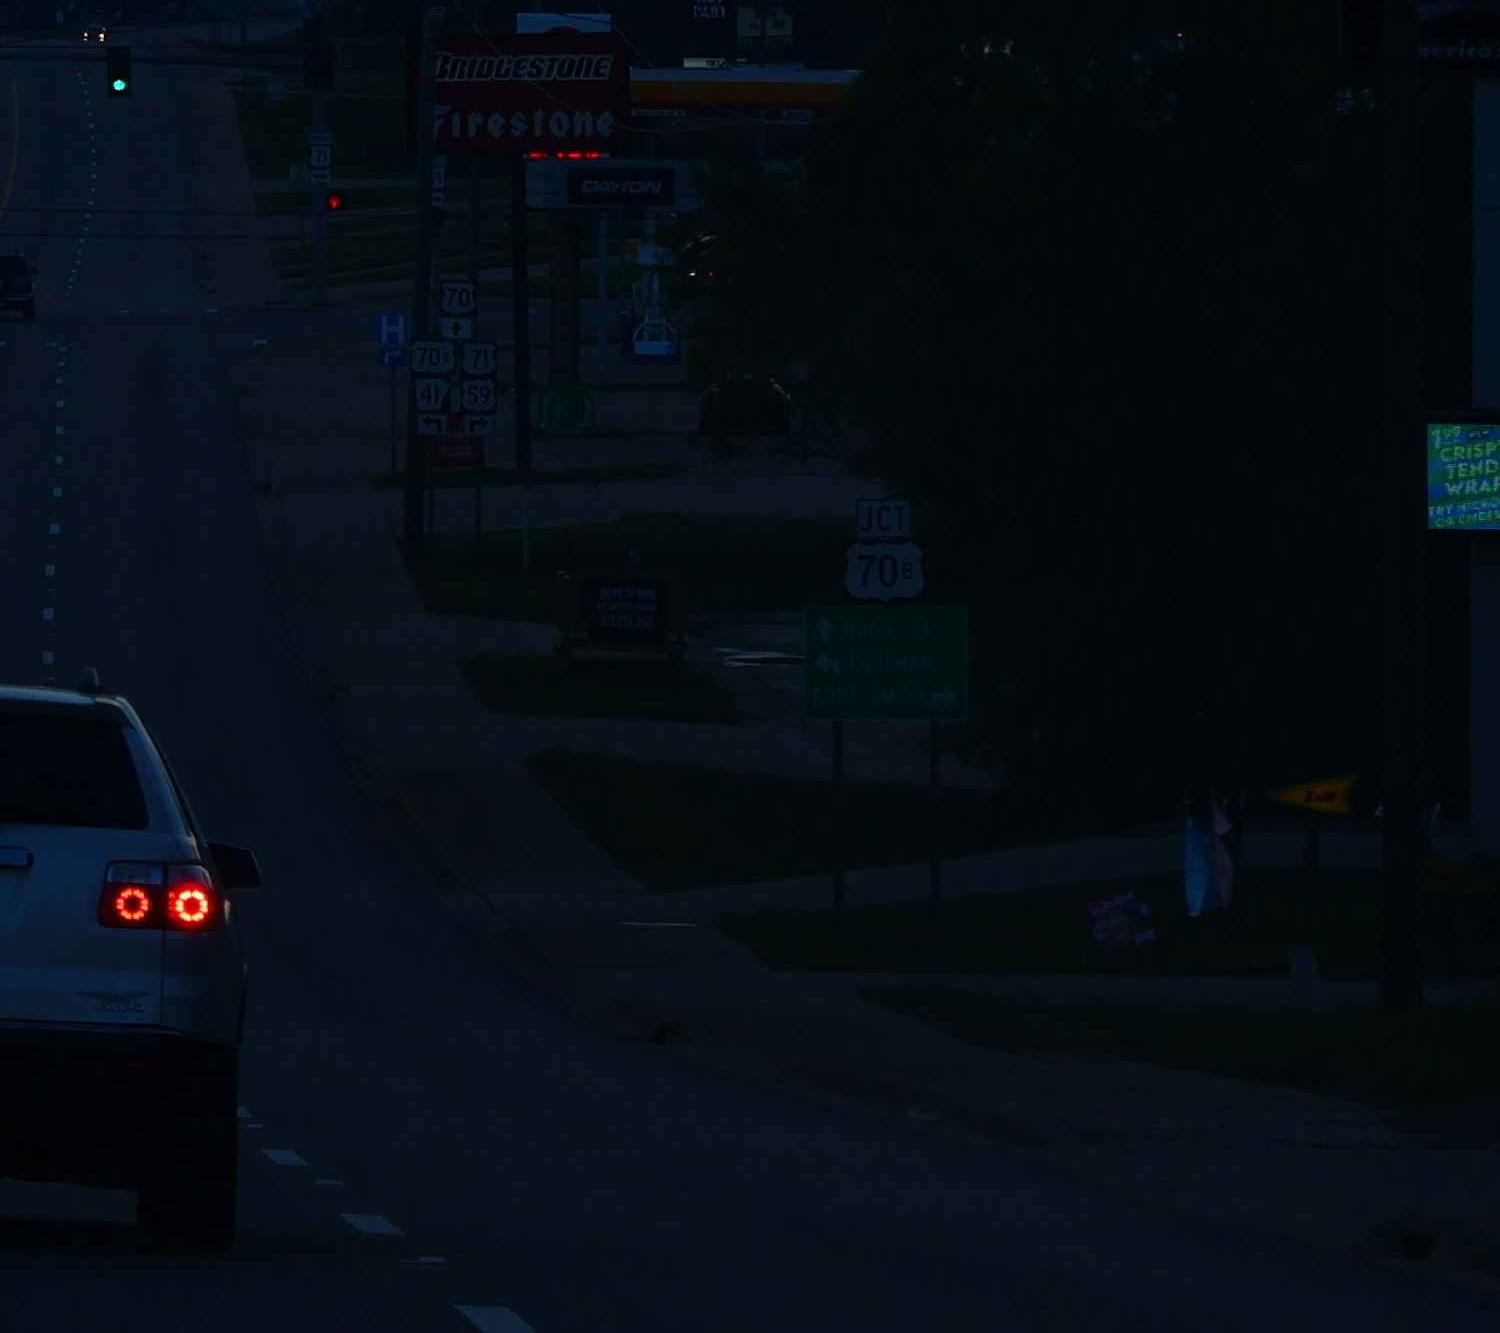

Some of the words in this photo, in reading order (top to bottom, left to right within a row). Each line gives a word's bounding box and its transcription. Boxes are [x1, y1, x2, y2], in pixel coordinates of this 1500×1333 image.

[692, 5, 726, 19] PART
[433, 51, 613, 83] BRIDGESTONE
[433, 104, 616, 139] Firestone
[580, 180, 662, 194] DAYTON
[447, 288, 470, 308] 70
[381, 314, 405, 345] H
[471, 349, 488, 368] 71
[420, 384, 439, 403] 41
[468, 386, 490, 405] 59
[860, 506, 906, 532] JCT
[844, 622, 891, 639] HUGO
[849, 654, 933, 672] FOREMAN
[813, 687, 857, 704] FORT
[870, 686, 924, 704] SMITH
